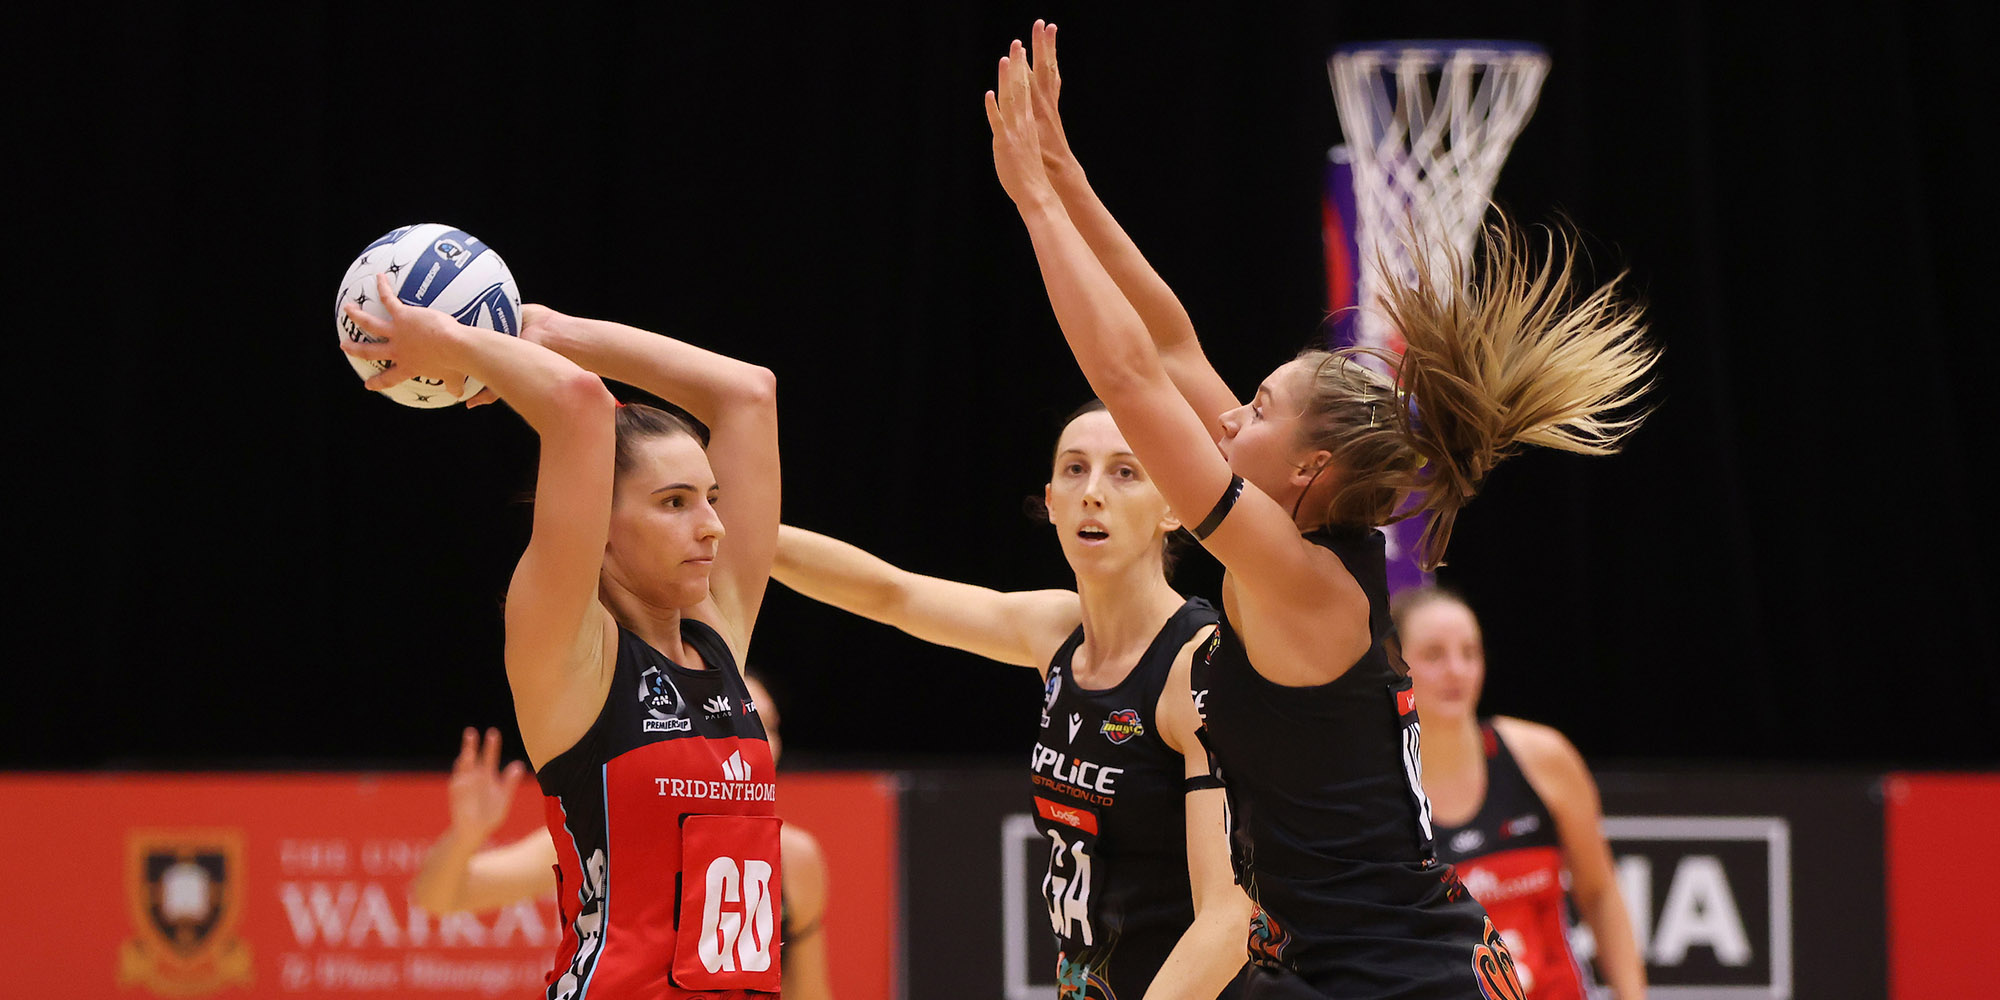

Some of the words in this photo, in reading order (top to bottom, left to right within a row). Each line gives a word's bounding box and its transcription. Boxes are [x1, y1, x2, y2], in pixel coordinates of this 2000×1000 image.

[1089, 794, 1114, 807] LTD
[698, 856, 774, 974] GD
[1042, 829, 1094, 947] GA
